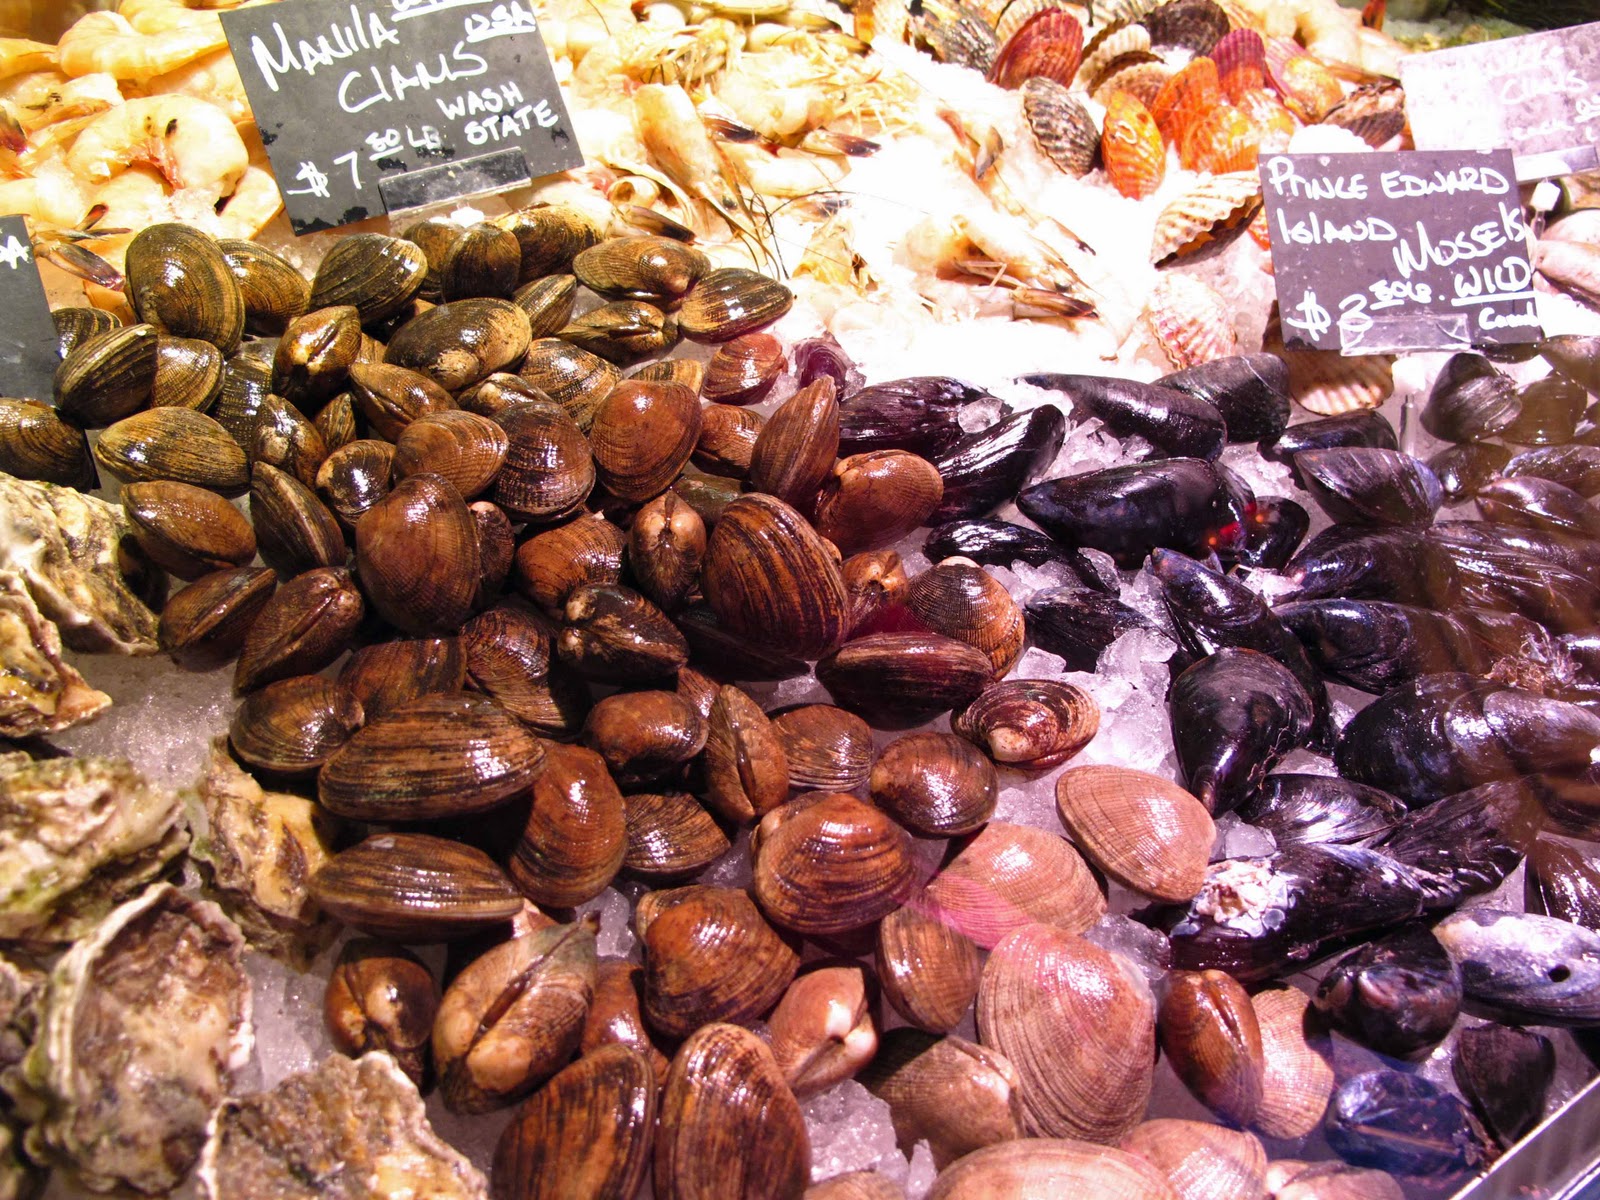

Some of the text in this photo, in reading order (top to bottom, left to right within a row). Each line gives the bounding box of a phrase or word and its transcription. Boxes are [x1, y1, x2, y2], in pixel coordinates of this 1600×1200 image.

[437, 82, 524, 120] WASH
[464, 99, 559, 146] STATE
[1380, 167, 1510, 198] EDWARD
[1454, 256, 1531, 298] WILD
